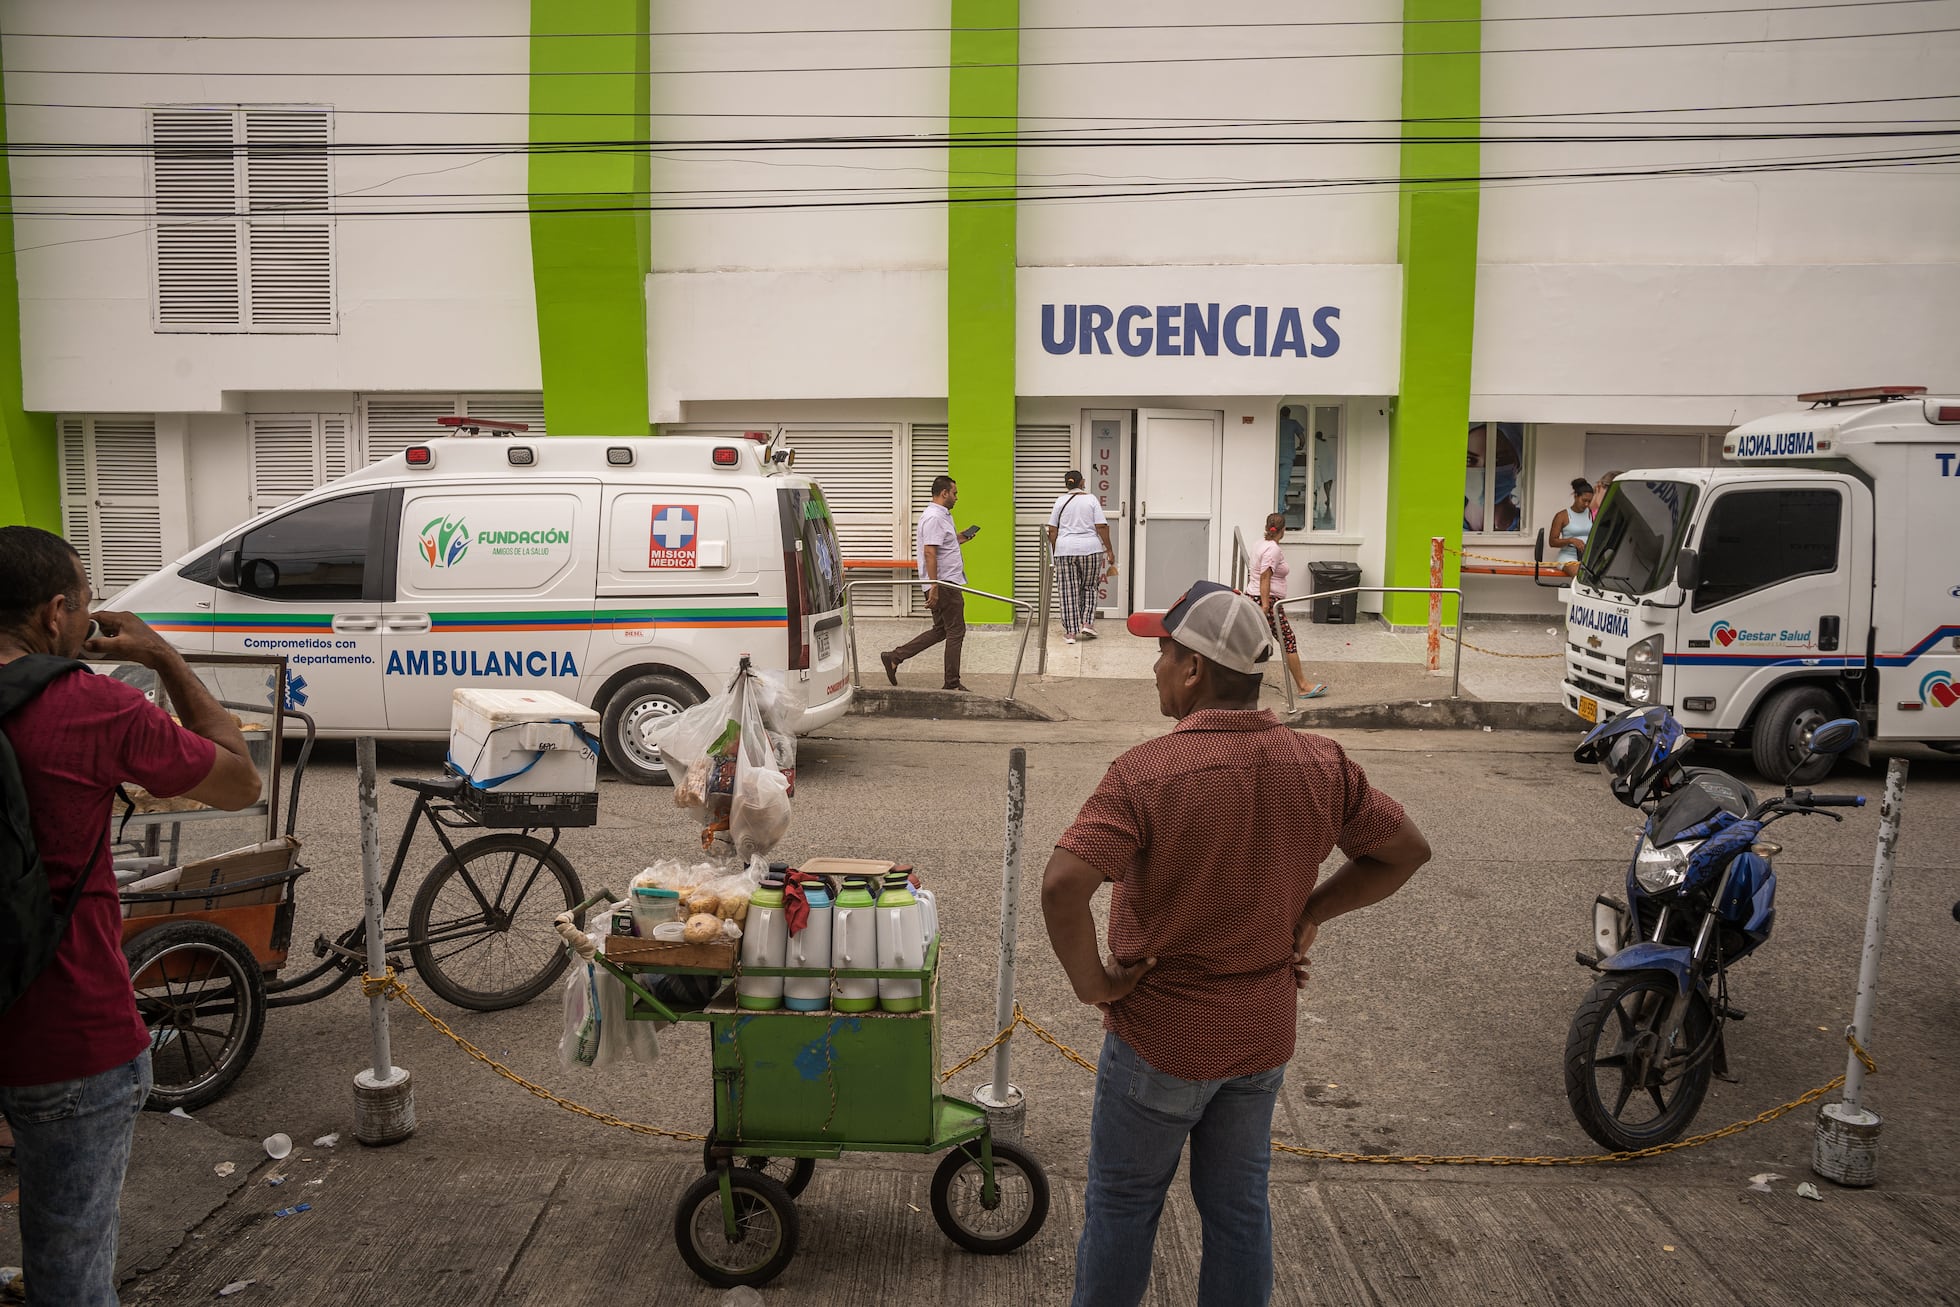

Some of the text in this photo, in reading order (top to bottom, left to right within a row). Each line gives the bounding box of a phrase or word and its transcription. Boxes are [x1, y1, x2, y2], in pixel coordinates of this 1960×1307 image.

[1041, 303, 1341, 359] URGENCIAS
[478, 528, 569, 544] FUNDACIÓN
[492, 547, 550, 556] AMIGOS DE LA SALUD
[651, 550, 696, 559] MISION
[650, 558, 695, 567] MEDICA
[1738, 629, 1812, 641] Gestar Salud
[243, 638, 356, 649] Comprometidos con
[292, 653, 375, 666] departamento.
[386, 650, 578, 677] AMBULANCIA
